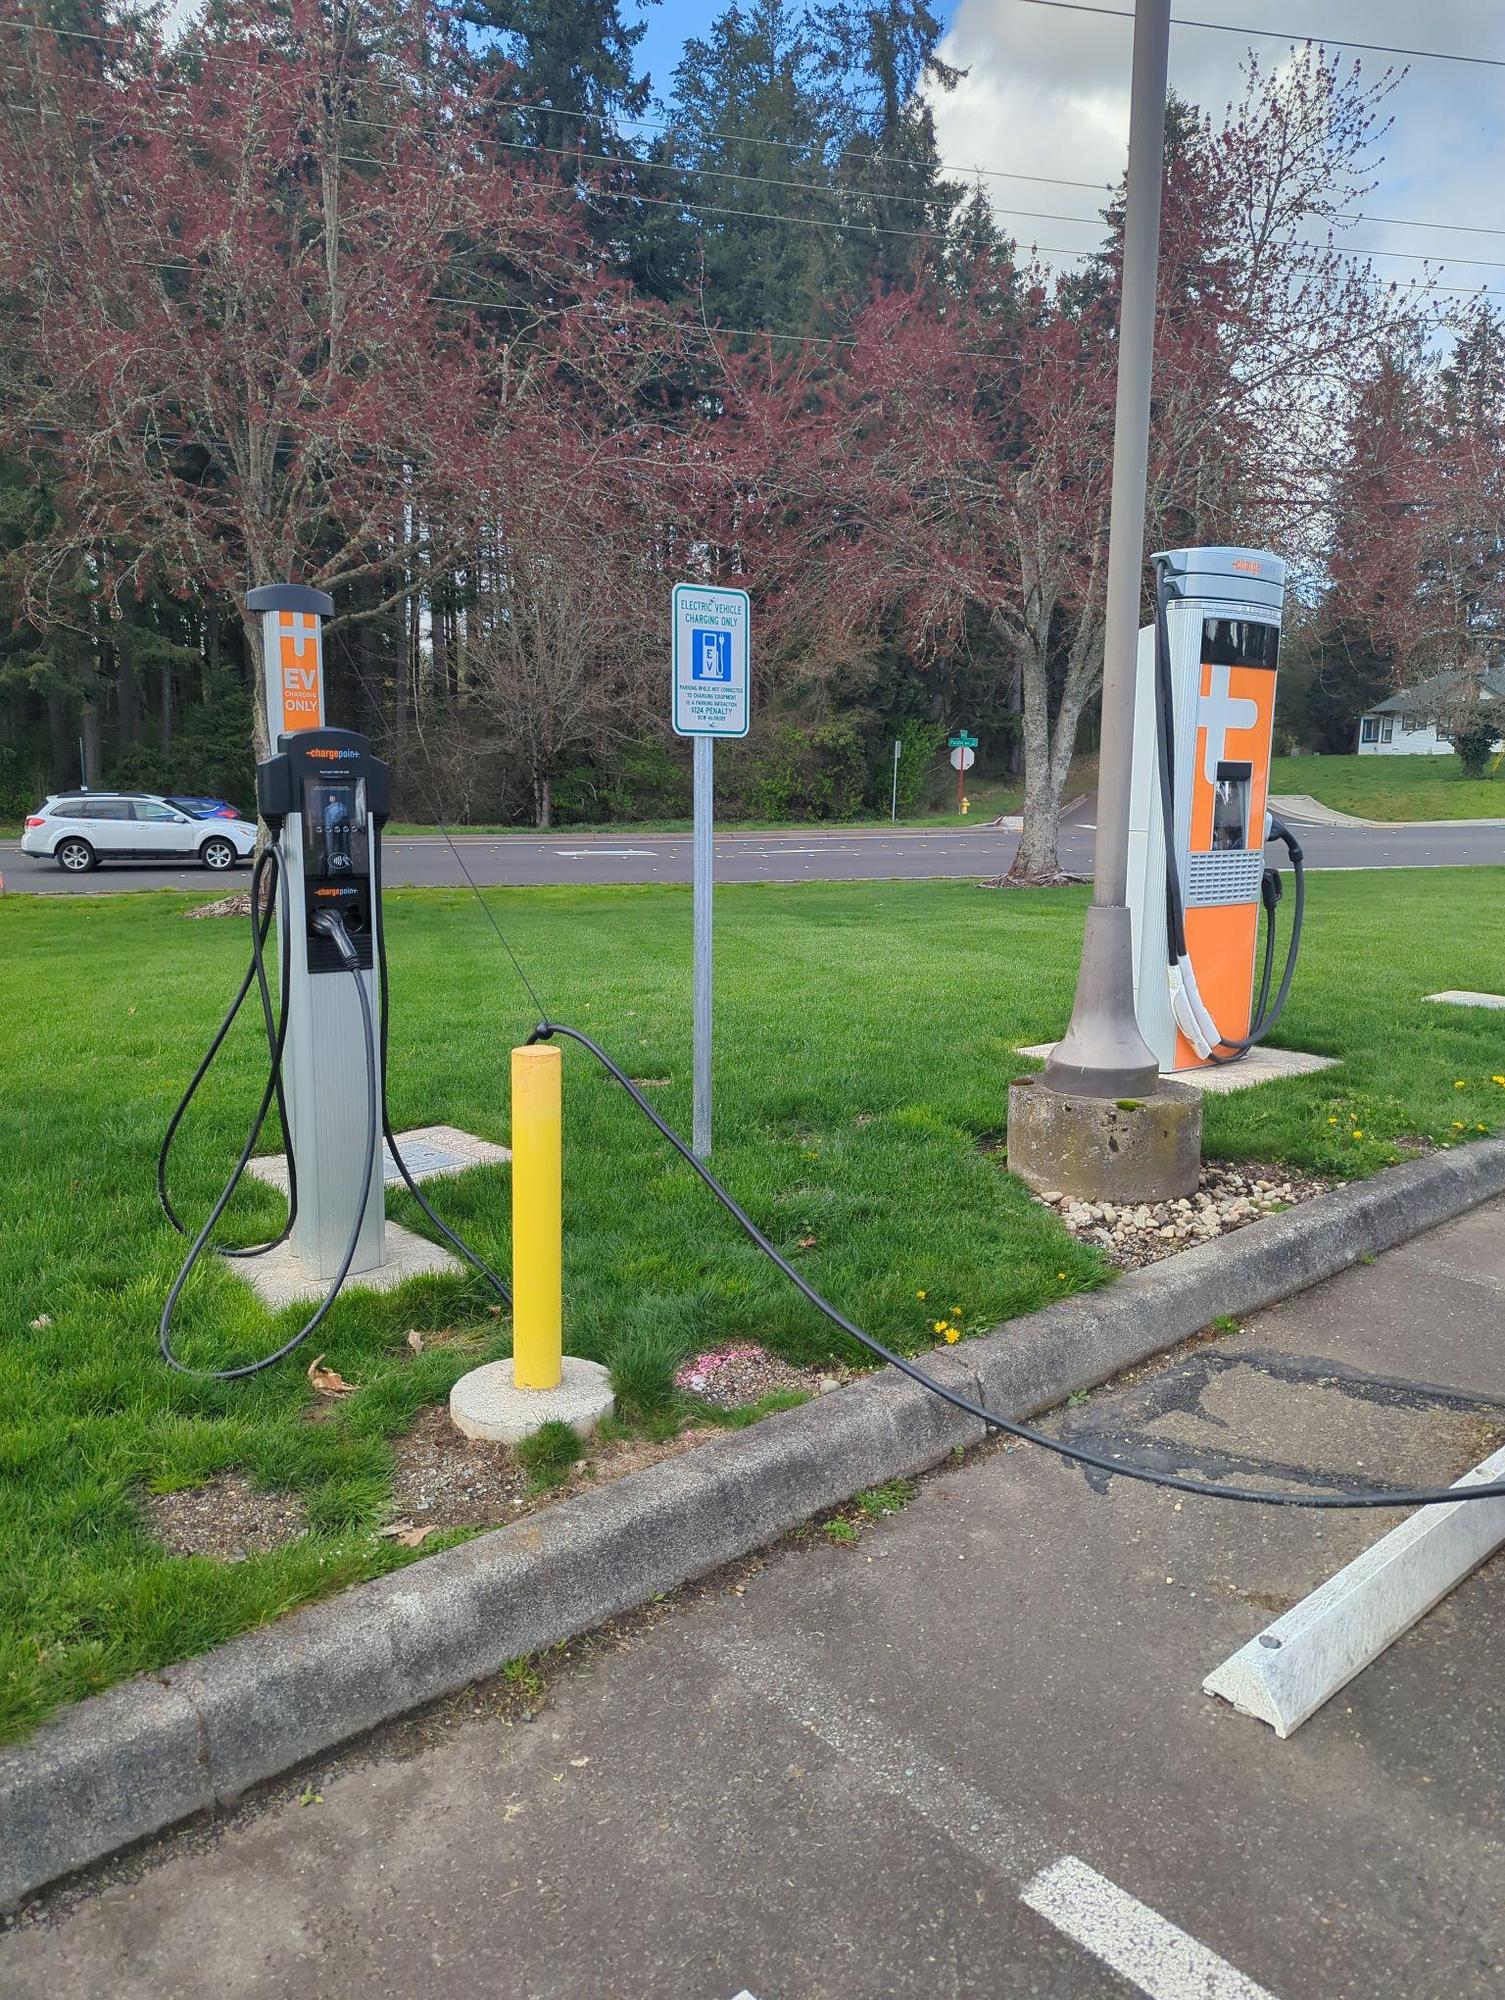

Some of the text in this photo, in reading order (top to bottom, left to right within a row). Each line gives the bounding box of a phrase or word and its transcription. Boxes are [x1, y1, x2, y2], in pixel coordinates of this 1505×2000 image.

[681, 600, 742, 615] ELECTRIC VEHICLE
[685, 613, 738, 627] CHARGING ONLY
[284, 668, 316, 690] EV
[285, 690, 318, 699] CHARGING
[285, 699, 318, 712] ONLY
[691, 706, 733, 716] $124 PENALTY
